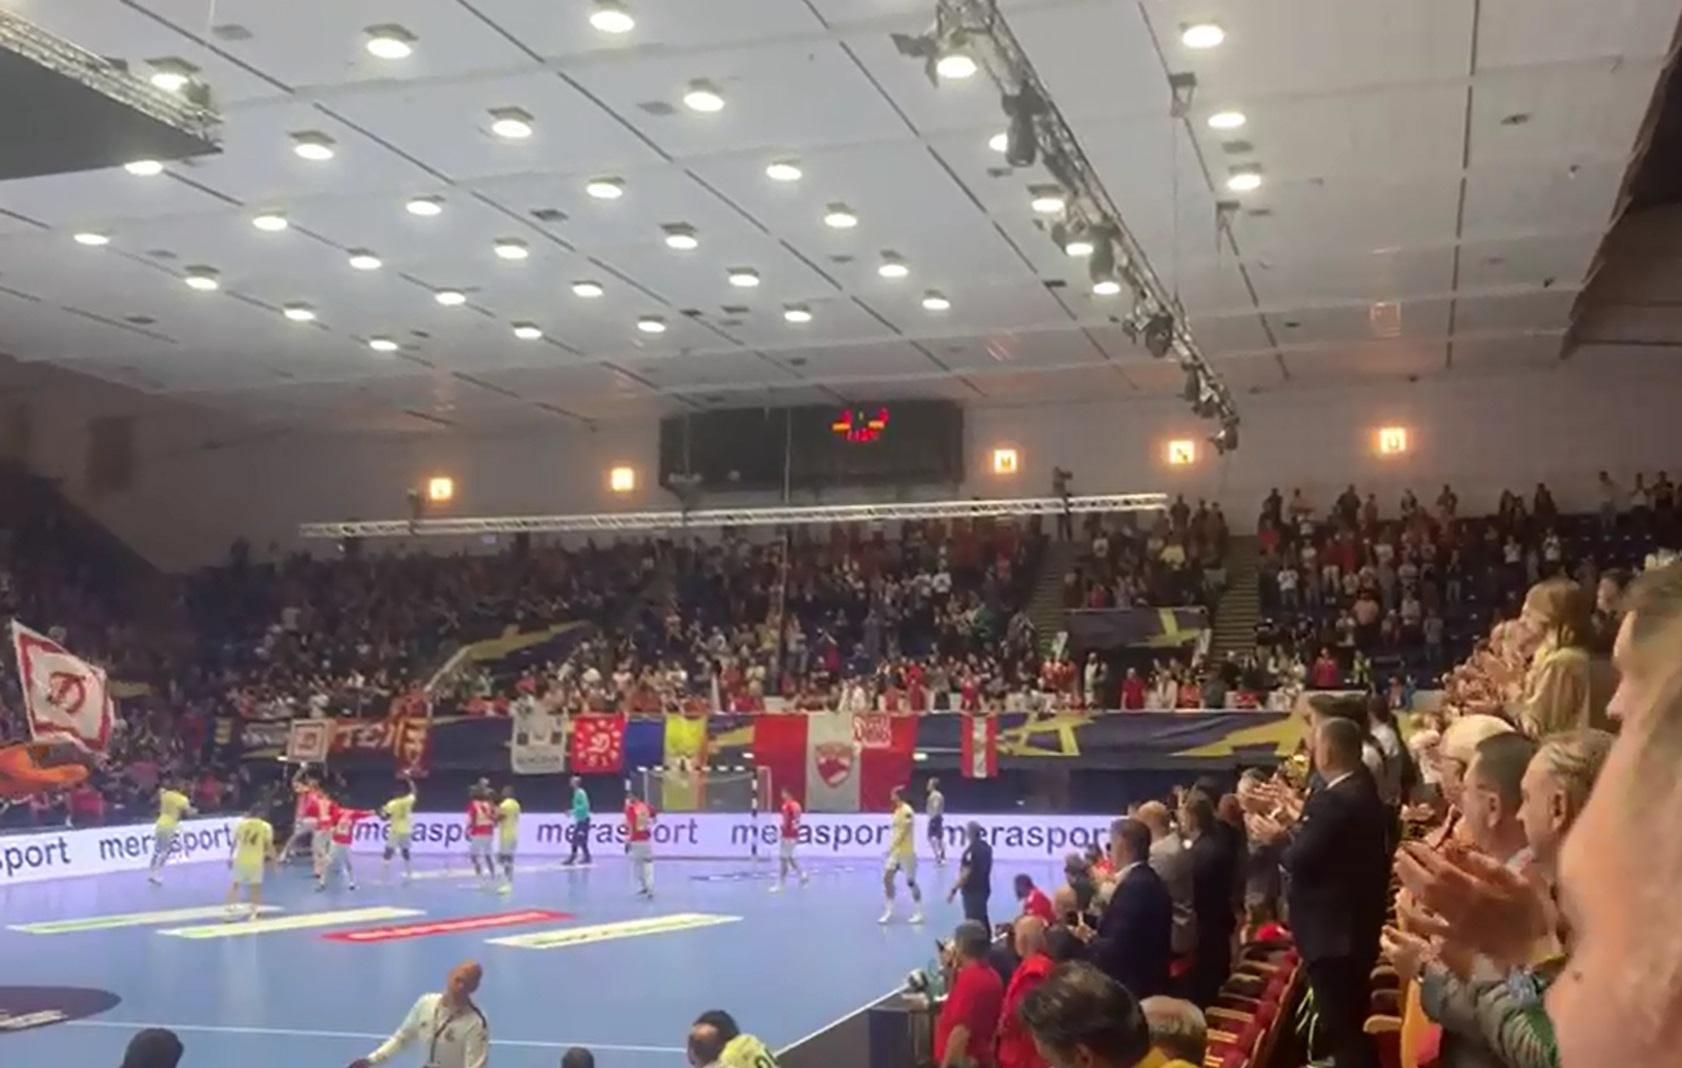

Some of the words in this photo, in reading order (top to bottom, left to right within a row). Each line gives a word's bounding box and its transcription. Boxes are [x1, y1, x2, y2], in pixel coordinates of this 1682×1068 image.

[99, 823, 234, 860] mersport
[537, 818, 698, 844] merasort
[731, 822, 890, 851] measpor
[0, 836, 70, 876] port
